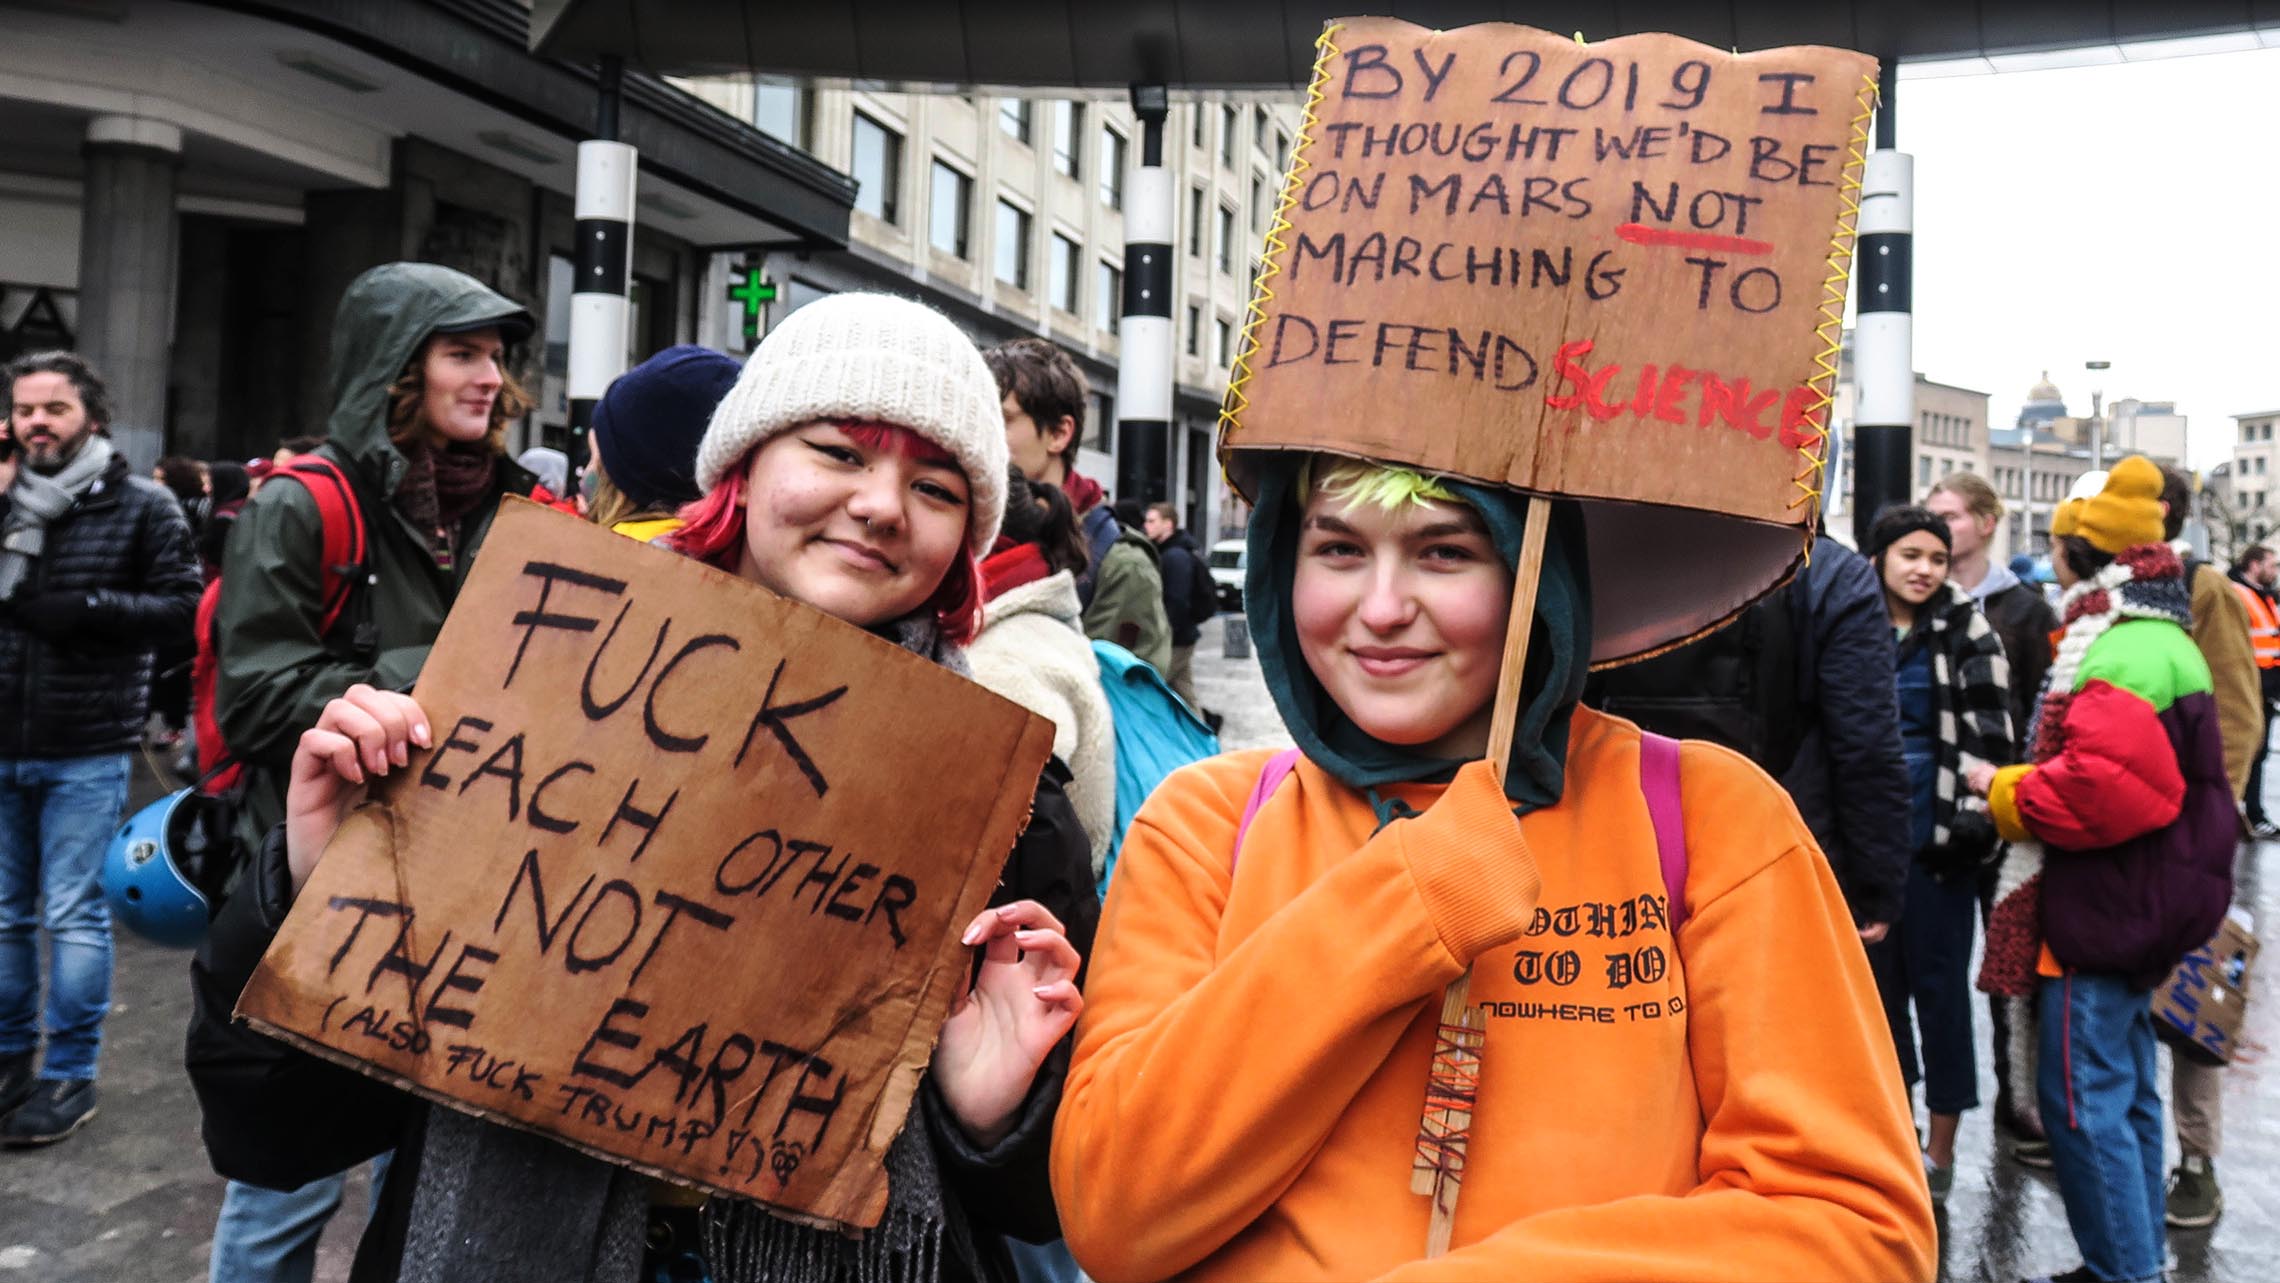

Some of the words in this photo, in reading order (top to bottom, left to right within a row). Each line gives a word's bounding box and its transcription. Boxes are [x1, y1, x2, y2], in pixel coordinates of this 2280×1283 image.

[1341, 45, 1456, 102] BY
[1491, 50, 1713, 111] 2019
[1758, 72, 1817, 116] I
[1326, 121, 1578, 163] THOUGHT
[1595, 121, 1731, 165] WE'D
[1748, 137, 1841, 188] BE
[1302, 171, 1386, 214] ON
[1408, 173, 1592, 219] MARS
[1630, 181, 1762, 236] NOT
[1289, 232, 1626, 301] MARCHING
[1685, 257, 1781, 314] TO
[1266, 313, 1538, 391] DEFEND
[1546, 339, 1826, 449] SCIENCE
[504, 561, 848, 798] FUCK
[421, 715, 679, 862] EACH
[716, 829, 917, 948] OTHER
[494, 848, 734, 988] NOT
[1524, 893, 1668, 939] OTHIN
[1513, 949, 1581, 987] TO
[1604, 945, 1666, 989] DO
[320, 996, 431, 1055] (ALSO
[447, 1044, 543, 1102] FUCK
[327, 895, 499, 1030] THE
[571, 999, 850, 1155] EARTH
[1480, 1001, 1615, 1023] NOWHERE
[1623, 1001, 1661, 1021] TO
[1668, 995, 1687, 1016] O
